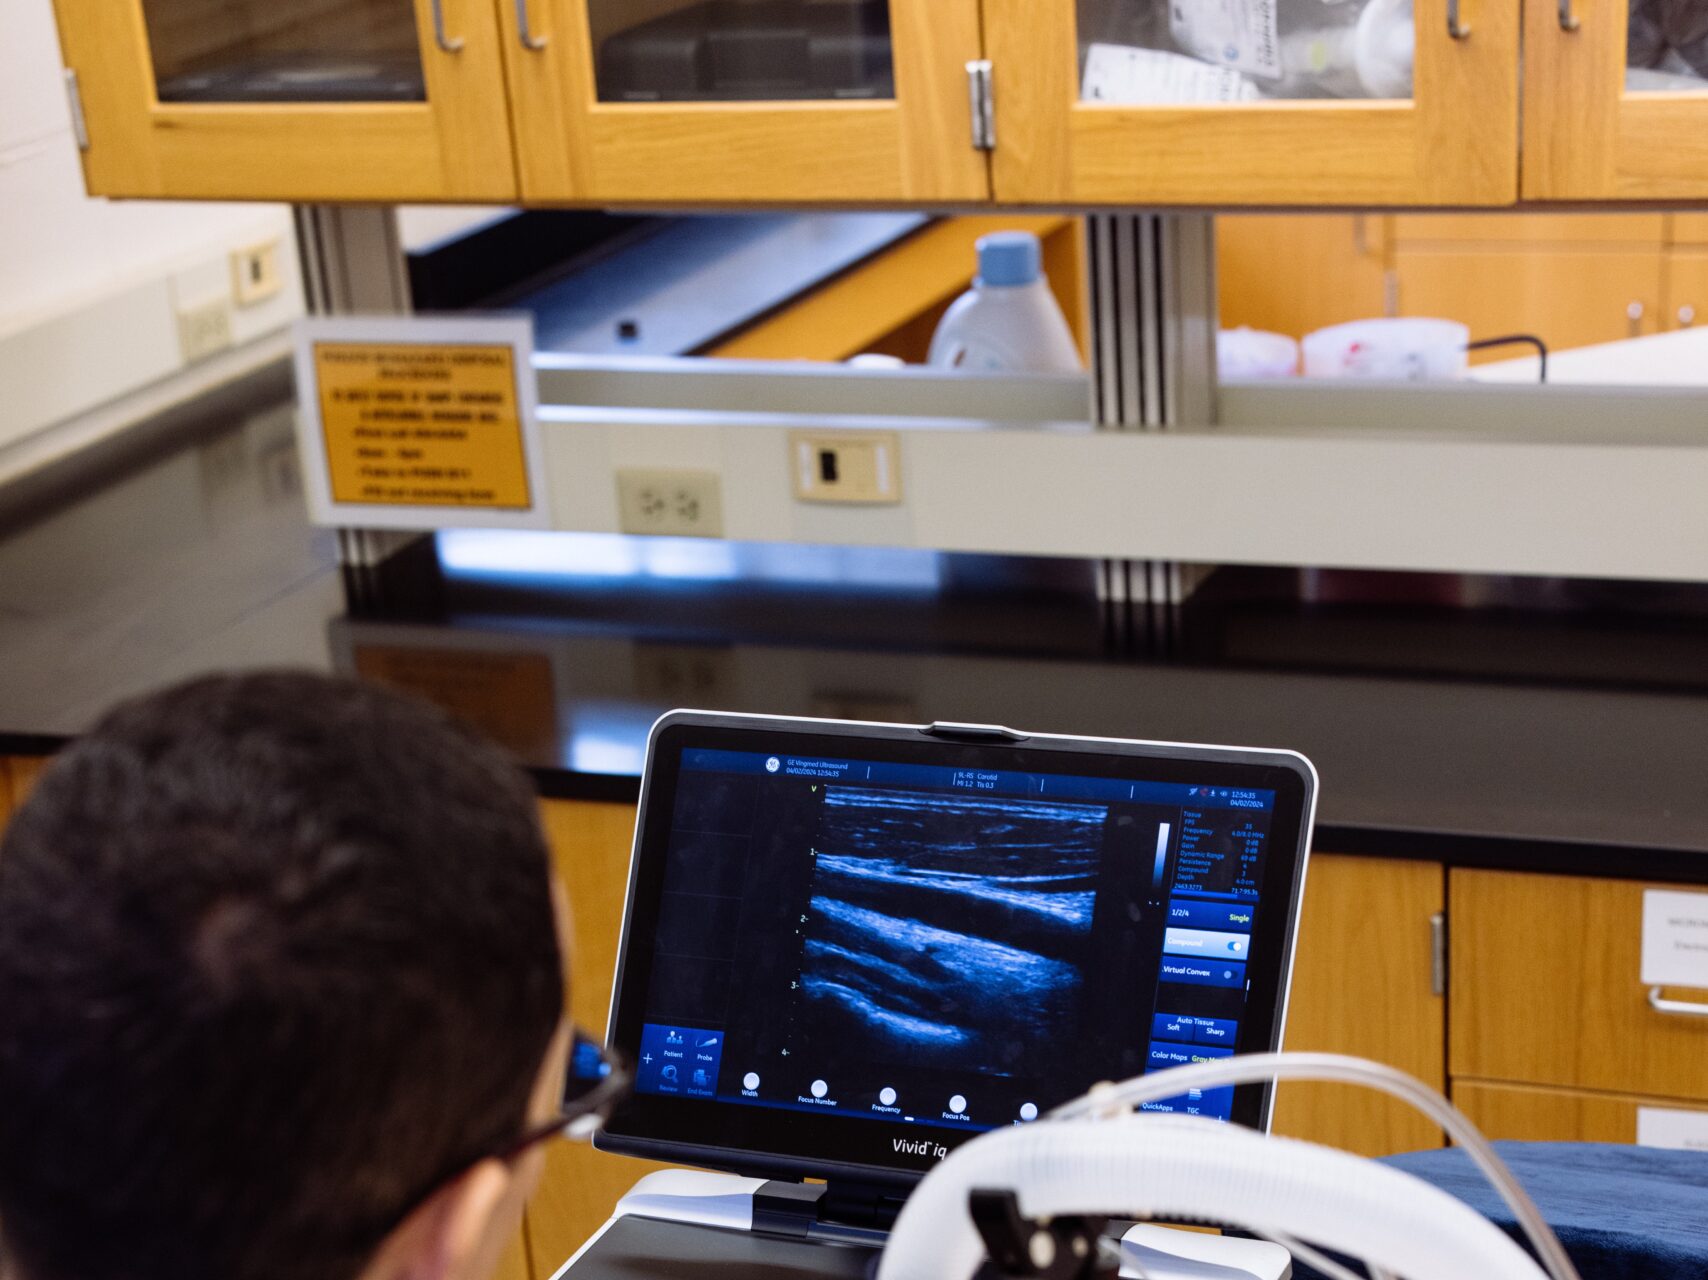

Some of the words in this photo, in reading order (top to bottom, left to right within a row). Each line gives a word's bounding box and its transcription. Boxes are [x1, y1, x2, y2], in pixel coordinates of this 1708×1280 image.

[819, 761, 848, 770] Ultrasound
[786, 767, 817, 775] 04/02/2024
[818, 769, 839, 777] 12:54:35
[977, 773, 998, 781] Carotid
[1231, 790, 1256, 799] 12:54:35
[1230, 799, 1264, 808] 04/02/2024
[1183, 826, 1214, 837] Frequency
[1180, 850, 1205, 858] Dynamic
[1206, 852, 1225, 861] Range
[1179, 858, 1212, 866] Persistence
[1177, 865, 1209, 874] Compound
[1177, 873, 1195, 881] Depth
[1171, 908, 1190, 917] 1/2/4
[1229, 913, 1250, 924] Single
[1163, 965, 1186, 974] Virtual
[1186, 967, 1210, 977] Convex
[1176, 1016, 1193, 1025] Auto
[1194, 1018, 1215, 1027] Tissue
[1167, 1023, 1180, 1032] Soft
[1206, 1027, 1225, 1037] Sharp
[663, 1050, 684, 1058] Patient
[697, 1053, 713, 1062] Probe
[1151, 1051, 1169, 1060] Color
[1170, 1053, 1188, 1062] Maps
[1191, 1054, 1208, 1063] Gray
[687, 1087, 698, 1095] End
[741, 1089, 759, 1097] Width
[798, 1095, 814, 1104] Focus
[814, 1097, 837, 1106] Number
[871, 1103, 901, 1115] Frequency
[1142, 1102, 1174, 1112] QuickApps
[1187, 1106, 1200, 1114] TGC
[942, 1111, 959, 1121] Focus
[959, 1113, 971, 1122] Pos
[933, 1143, 947, 1161] iq
